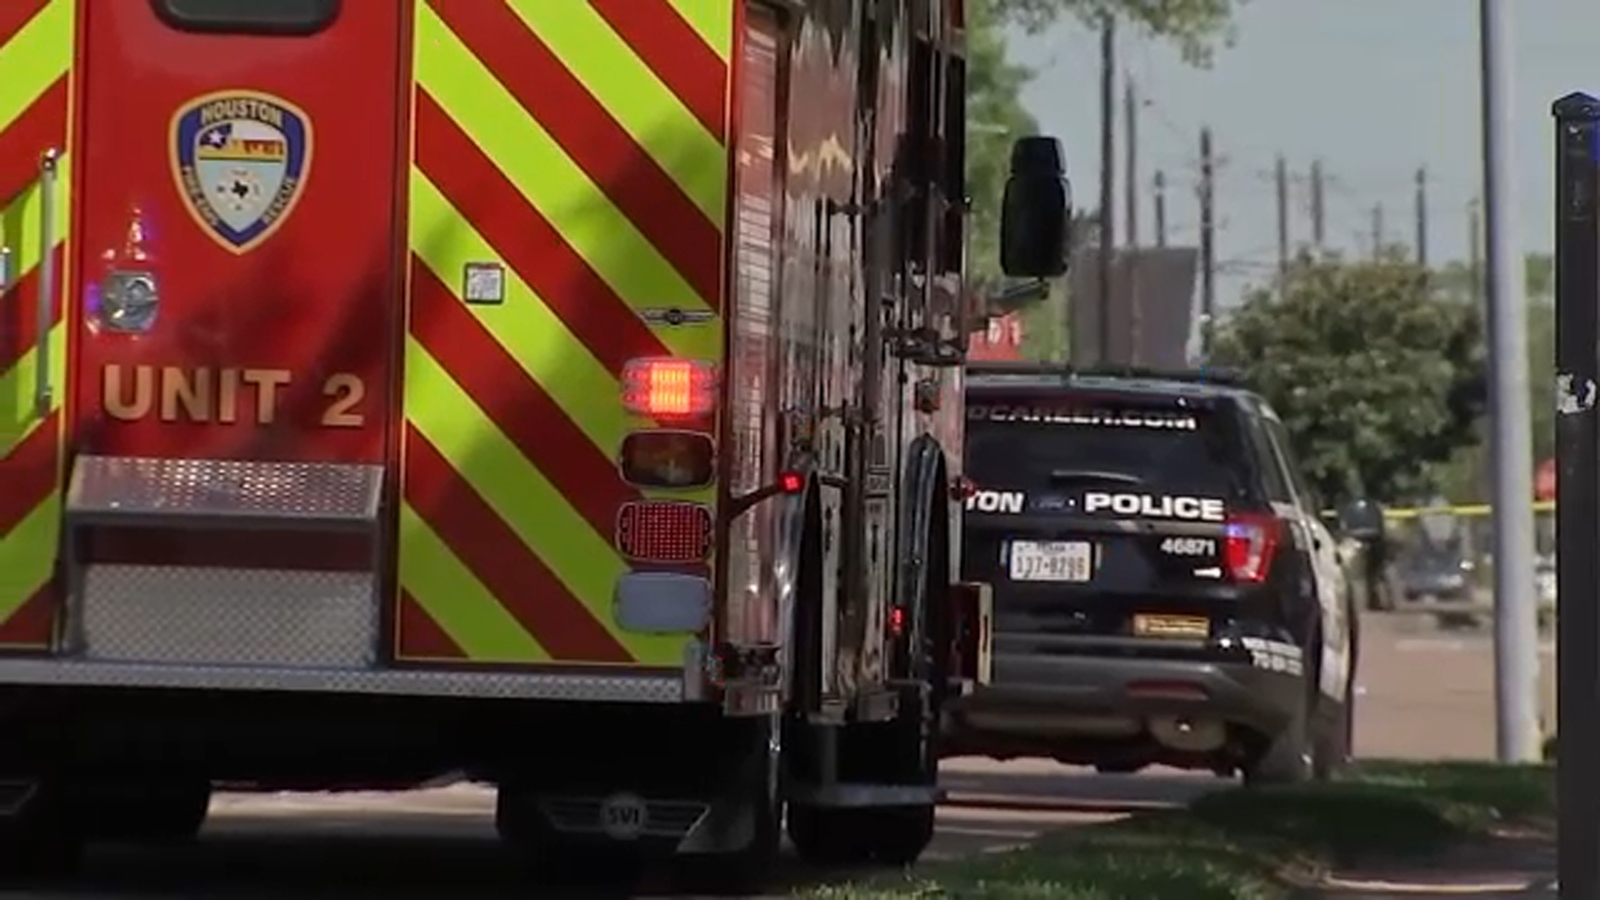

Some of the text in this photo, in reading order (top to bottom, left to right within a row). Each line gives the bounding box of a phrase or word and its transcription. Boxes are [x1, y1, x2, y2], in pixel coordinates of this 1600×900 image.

[201, 98, 283, 128] HOUSTON
[103, 364, 366, 427] UNIT 2
[1084, 492, 1226, 522] POLICE
[1160, 537, 1216, 557] 46871
